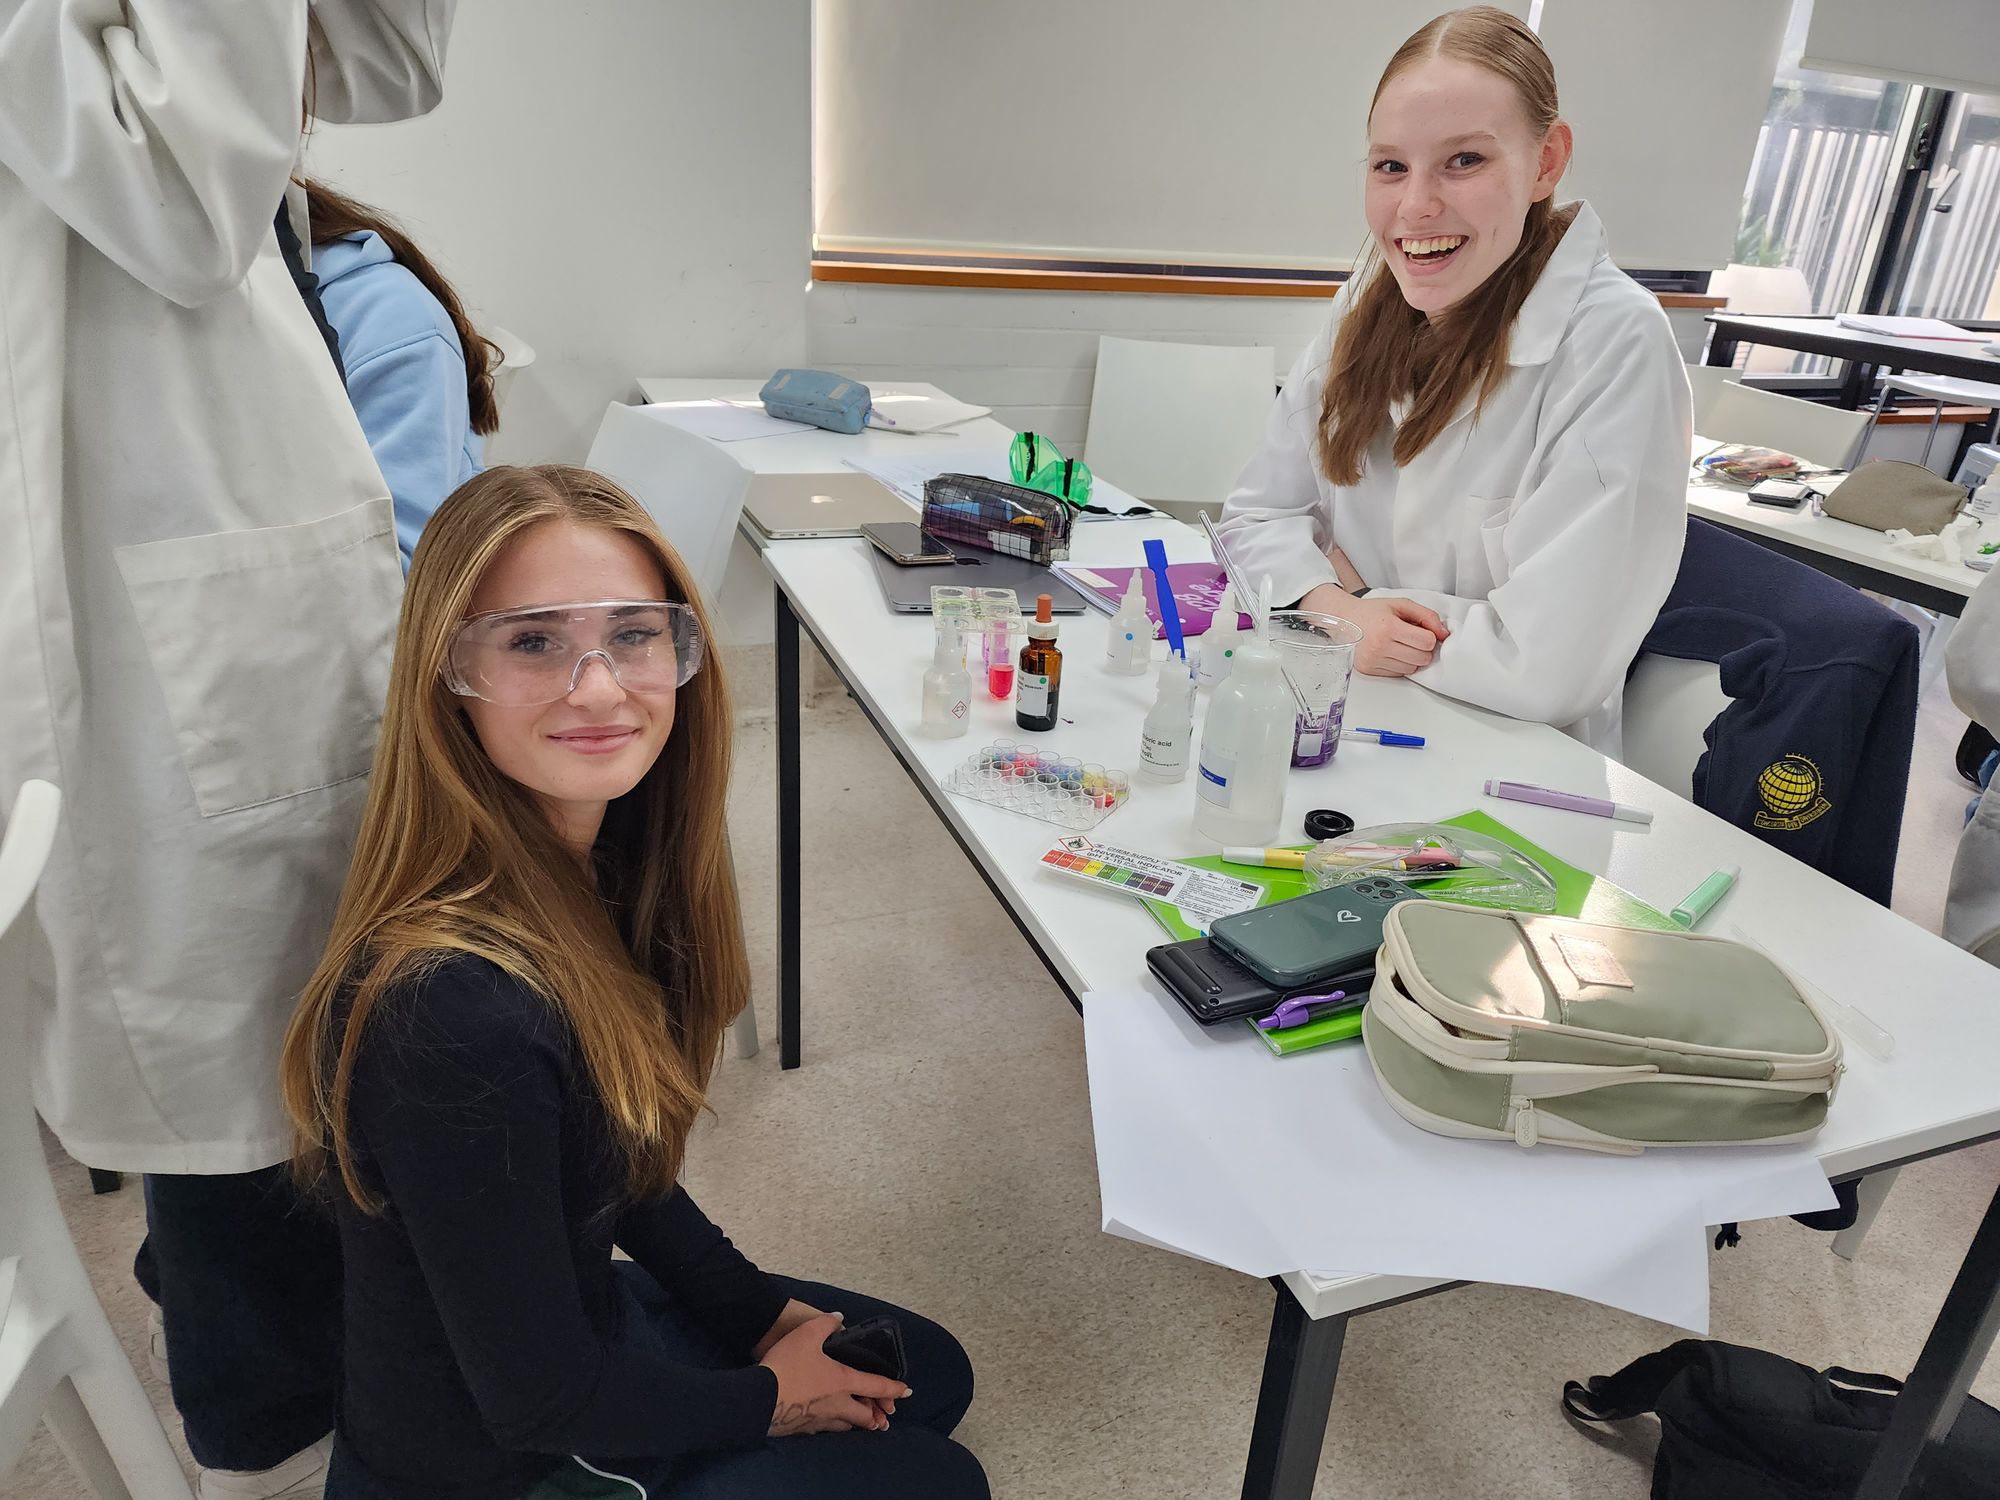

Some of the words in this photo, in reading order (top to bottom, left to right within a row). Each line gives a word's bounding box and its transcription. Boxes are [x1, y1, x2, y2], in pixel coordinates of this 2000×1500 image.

[1090, 848, 1137, 866] UNIVERSAL
[1137, 860, 1183, 877] INDICATOR
[1107, 846, 1162, 864] CHEM-SUPPLY
